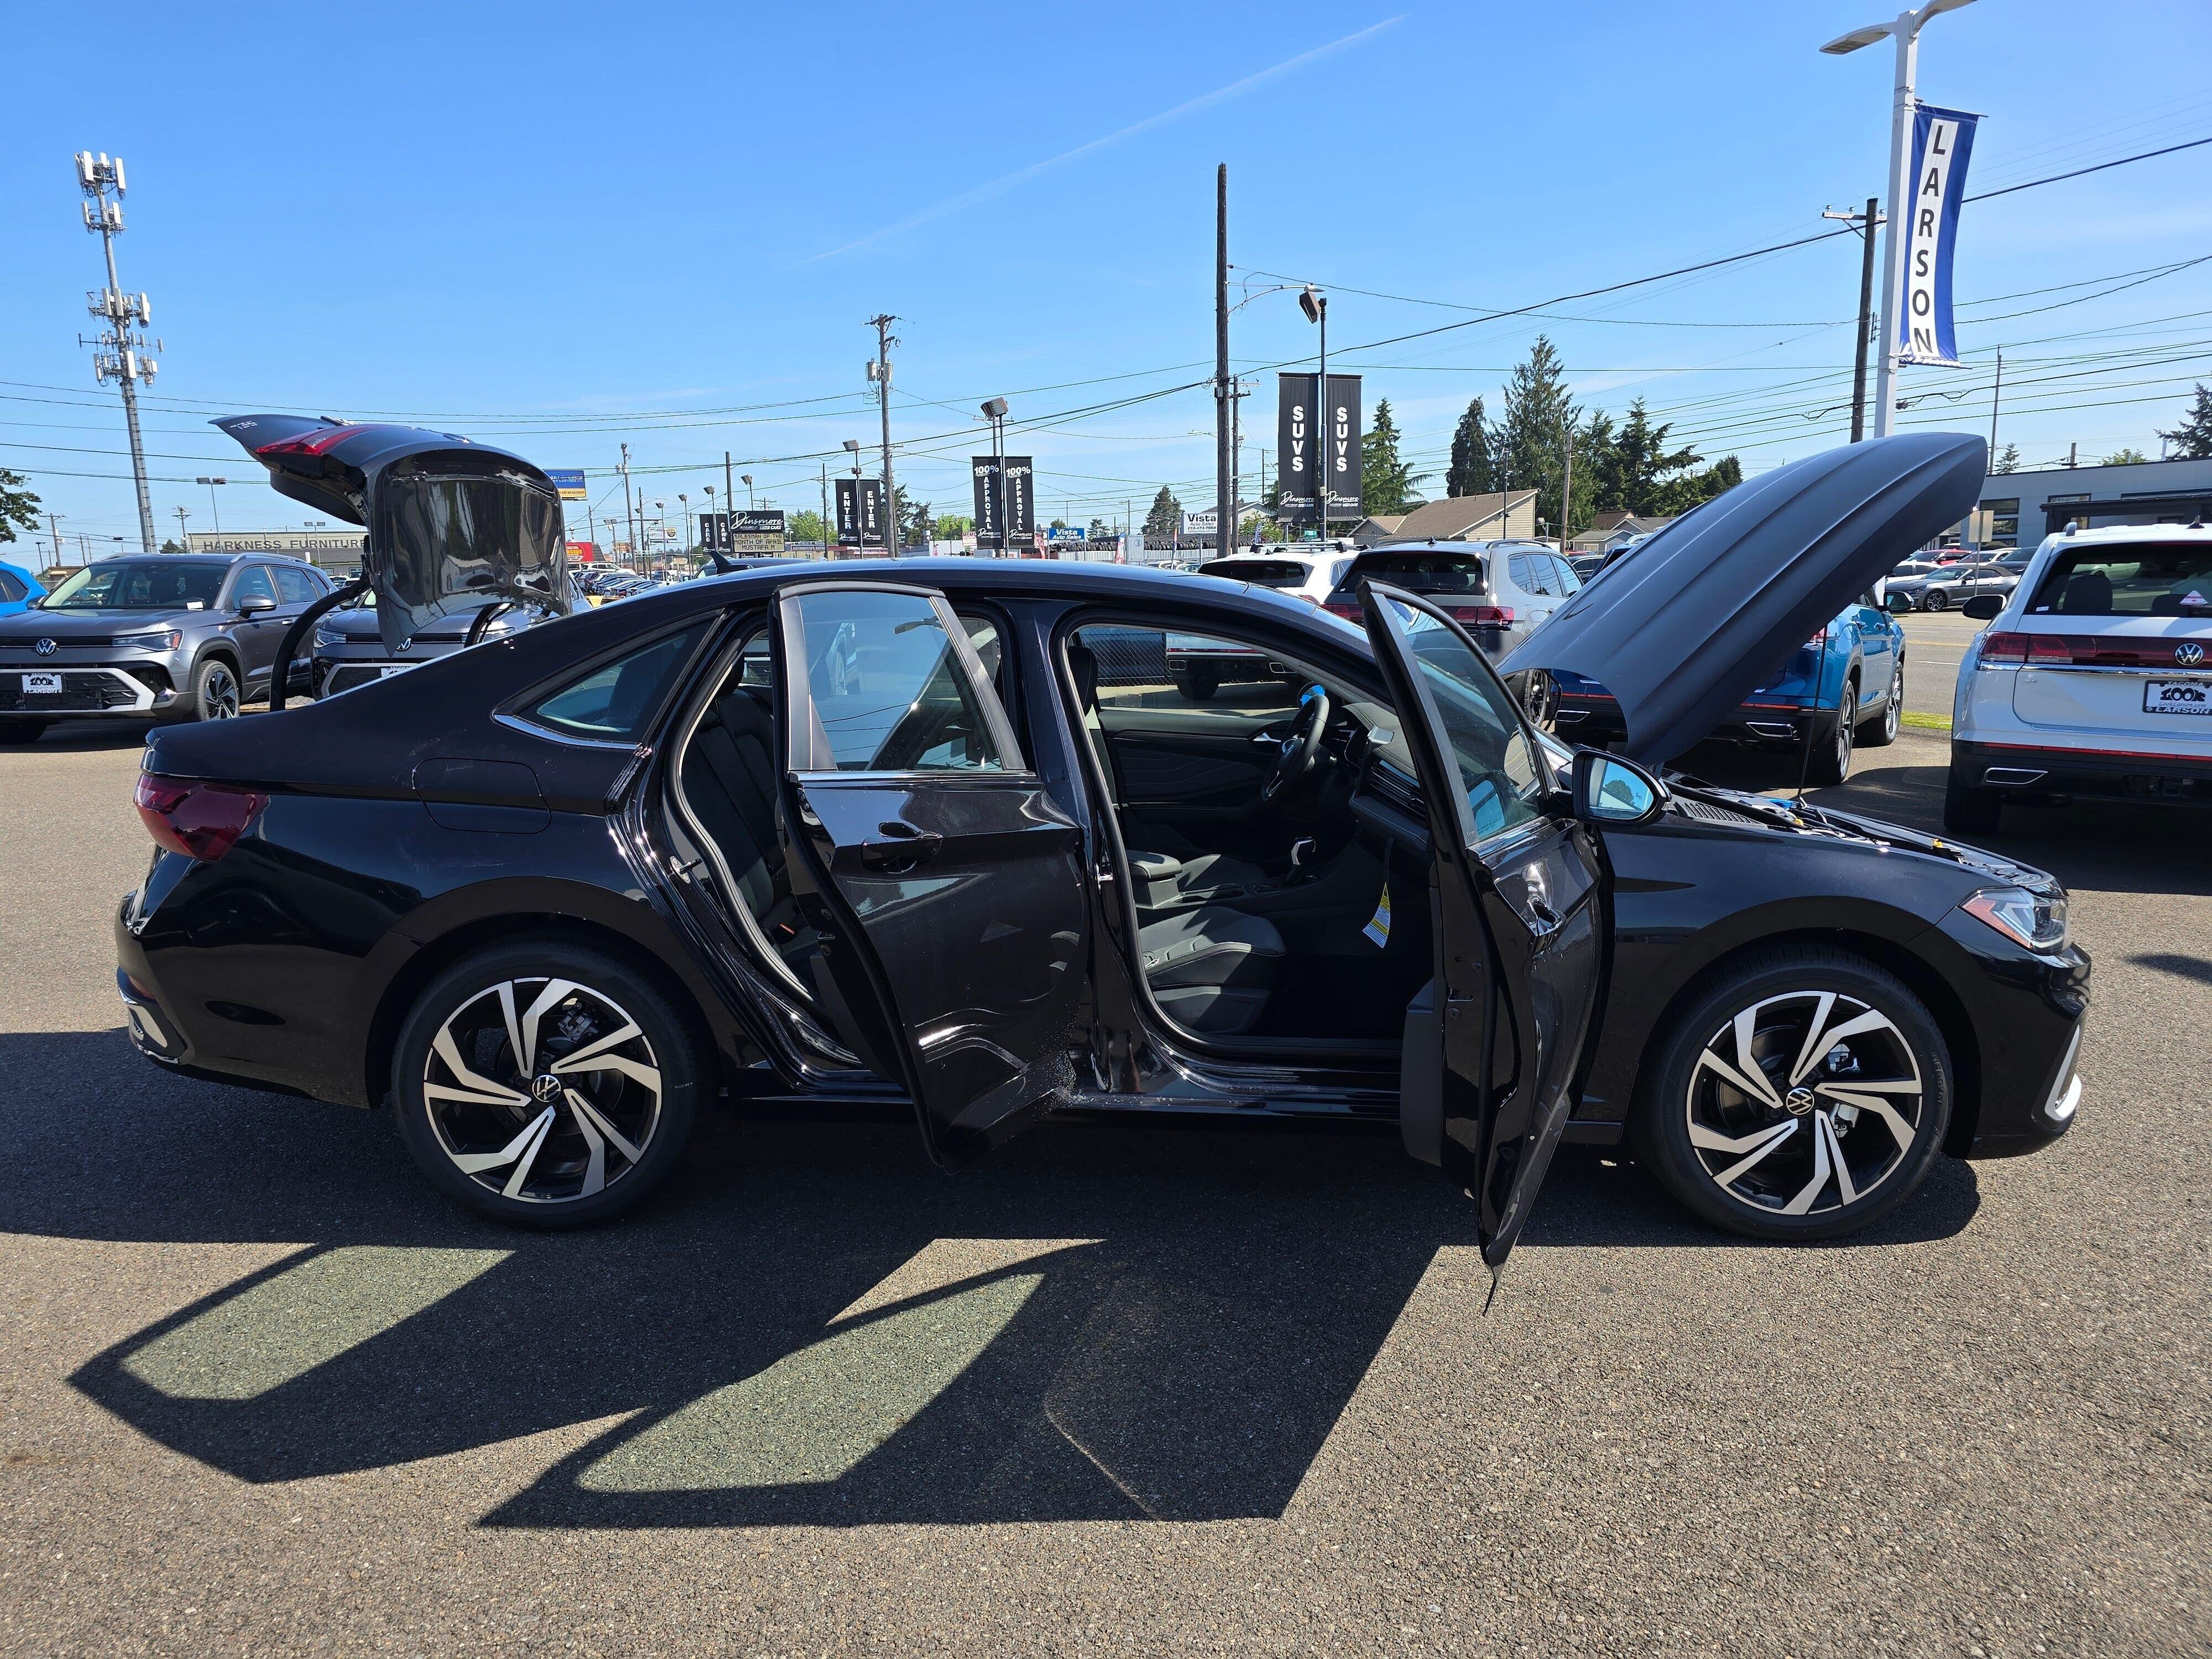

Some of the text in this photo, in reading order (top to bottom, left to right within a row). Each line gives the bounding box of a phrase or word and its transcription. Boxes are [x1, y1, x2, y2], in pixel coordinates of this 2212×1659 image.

[1912, 125, 1945, 353] LARSON
[1292, 405, 1305, 472] SUVS
[1336, 406, 1348, 472] SUVS
[974, 465, 999, 474] 100%
[1006, 466, 1031, 476] 100%
[731, 511, 783, 530] Dinsmore
[843, 492, 852, 529] ENTER
[867, 491, 875, 528] ENTER
[983, 477, 992, 529] APPROVAL
[204, 540, 282, 550] HARKNESS
[2160, 687, 2206, 702] LOOK
